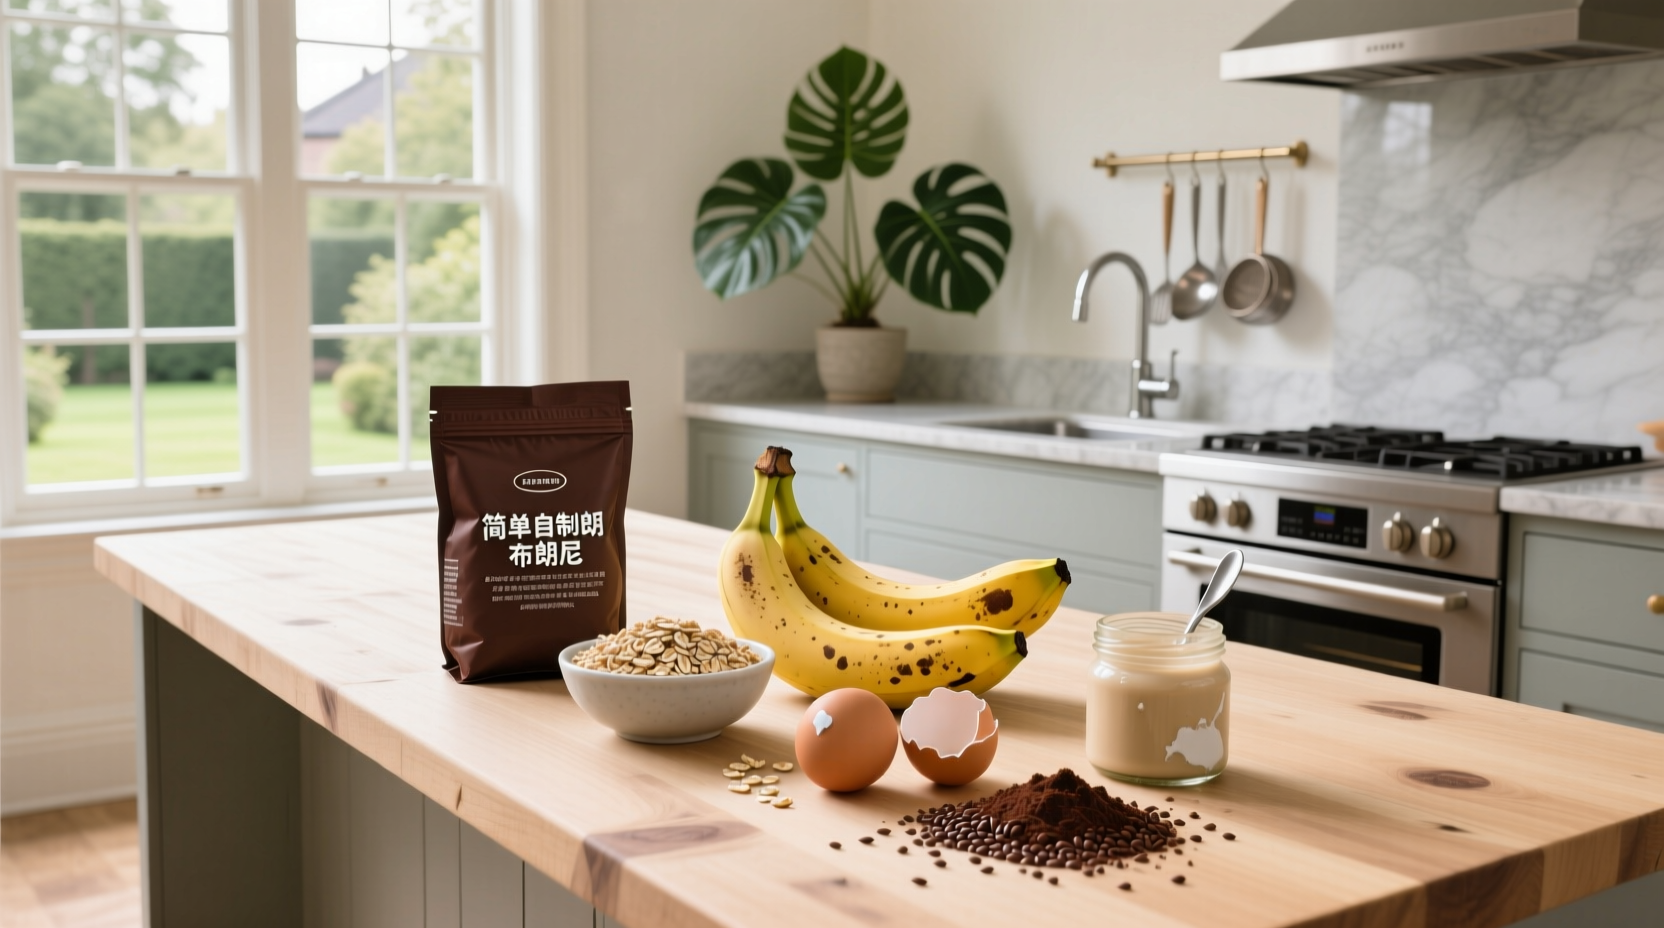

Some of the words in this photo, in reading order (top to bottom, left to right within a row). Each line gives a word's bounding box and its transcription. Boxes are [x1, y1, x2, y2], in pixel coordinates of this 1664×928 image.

[482, 511, 604, 541] 简单自制朗
[508, 540, 583, 568] 布朗尼
